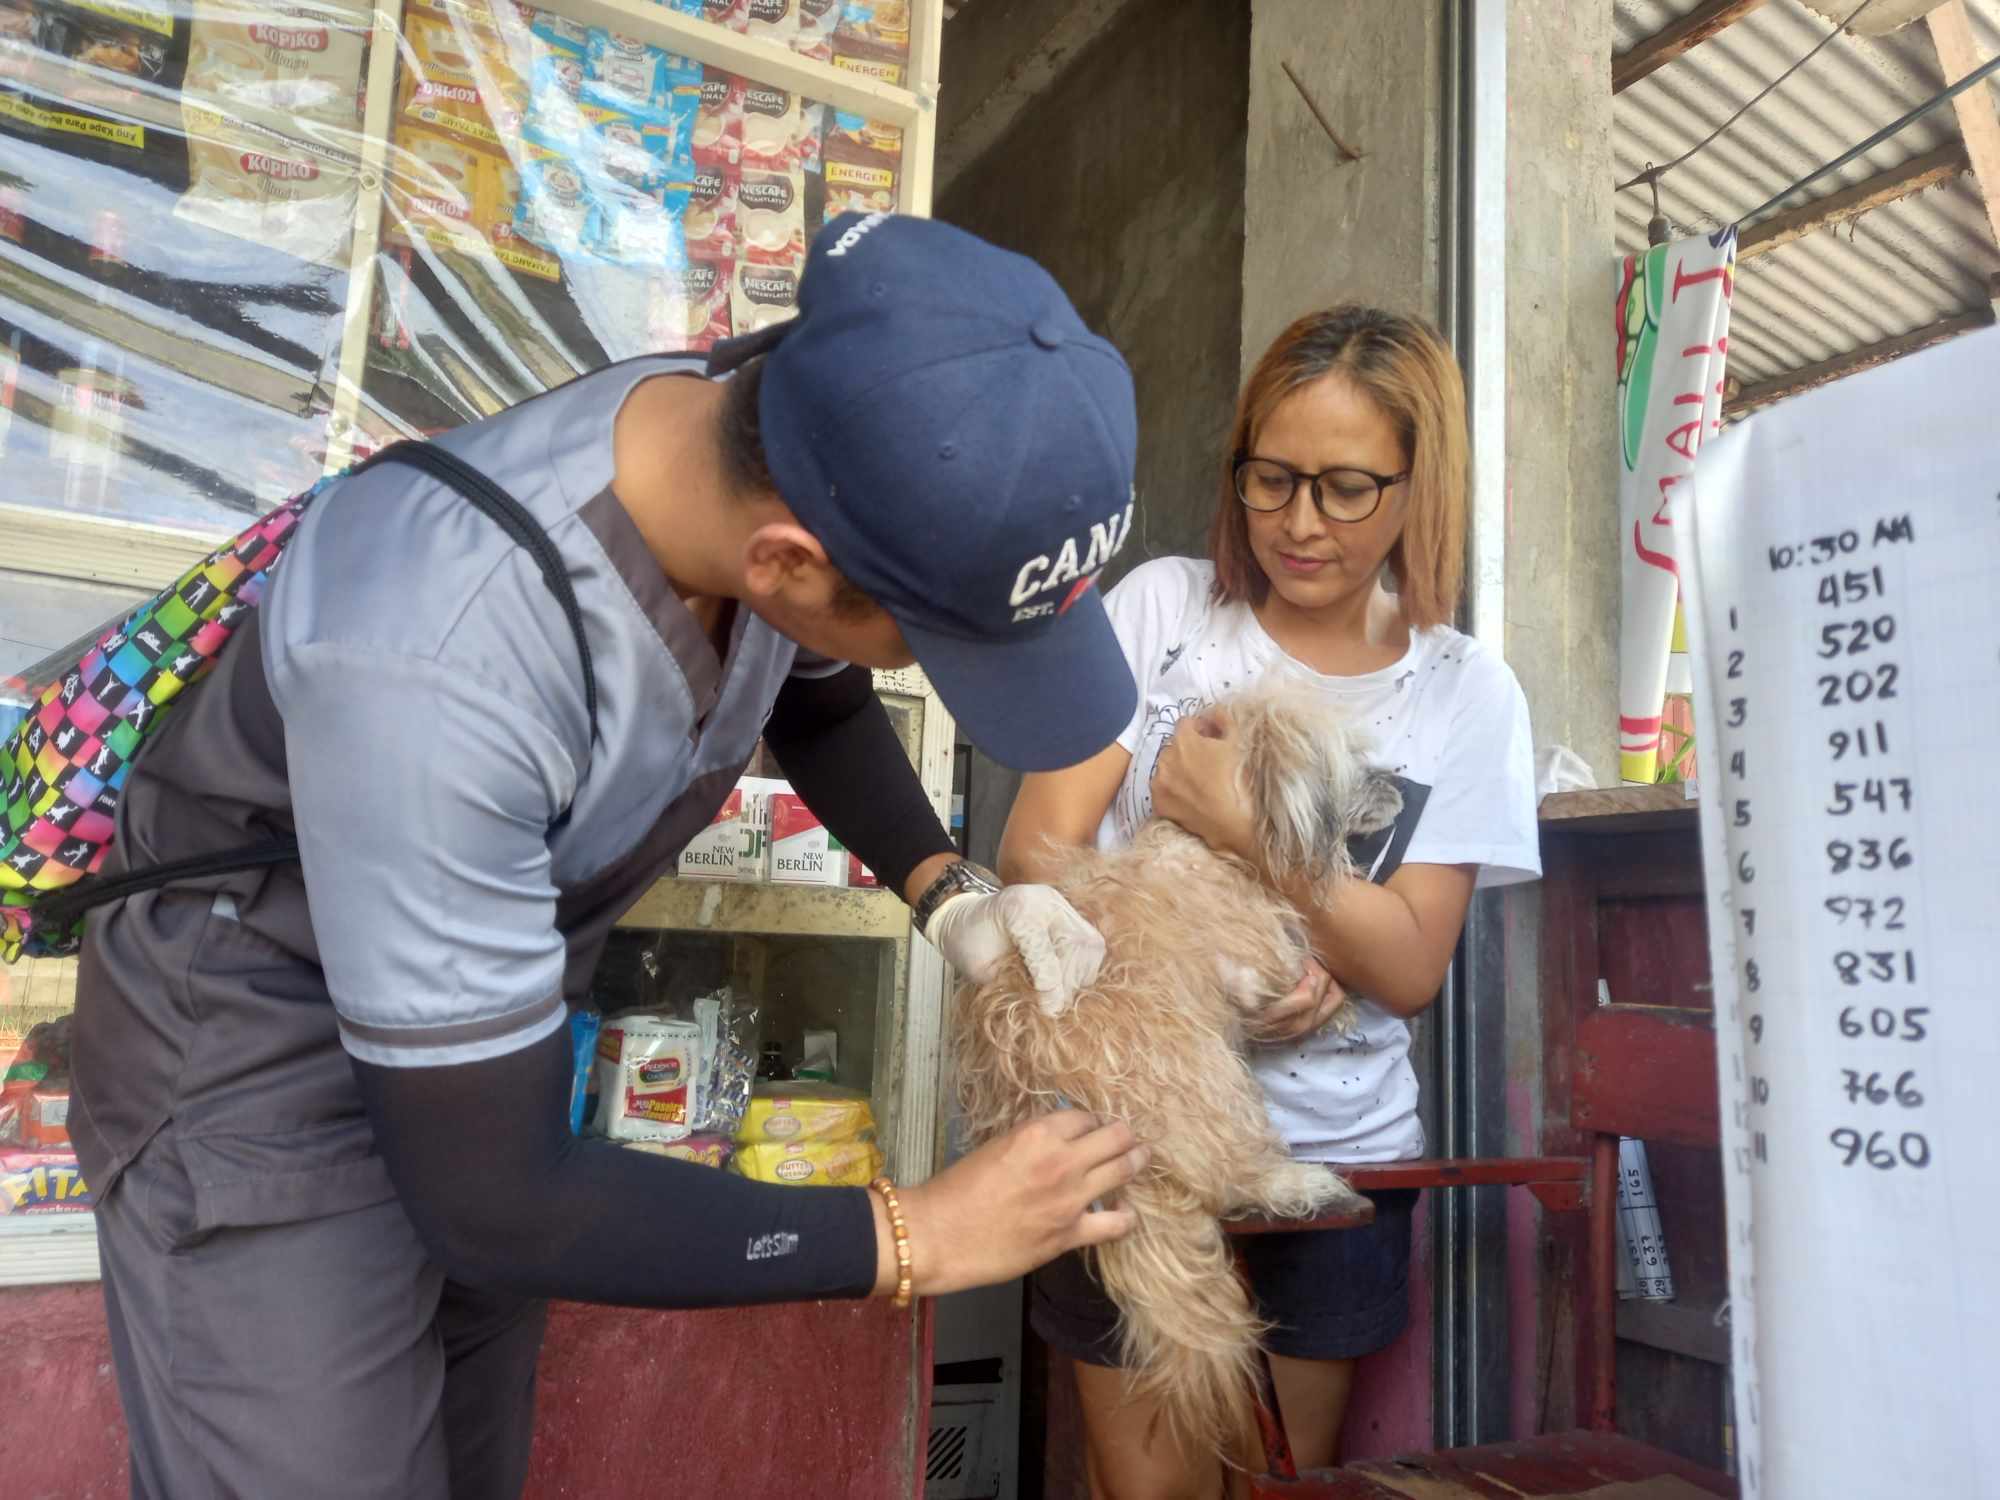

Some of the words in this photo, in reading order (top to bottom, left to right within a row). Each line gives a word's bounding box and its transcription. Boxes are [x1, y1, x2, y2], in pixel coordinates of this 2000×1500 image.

[256, 25, 320, 49] KOPIKO
[839, 61, 895, 78] ENERGEN
[423, 82, 476, 103] KOPIKO
[247, 153, 311, 178] KOPIKO
[831, 167, 889, 183] ENERGEN
[1769, 530, 1859, 572] 10:30
[1873, 513, 1914, 547] AM
[1817, 566, 1884, 608] 451
[1817, 615, 1896, 659] 520
[1727, 651, 1745, 679] 2
[1817, 663, 1899, 706] 202
[1726, 698, 1747, 728] 3
[1828, 721, 1889, 761] 911
[1730, 751, 1746, 779] 4
[1826, 778, 1913, 816] 547
[1733, 800, 1751, 827] 5
[684, 851, 734, 866] BERLIN
[712, 845, 735, 855] NEW
[776, 858, 823, 871] BERLIN
[803, 852, 824, 861] NEW
[1738, 851, 1755, 884] 6
[1740, 908, 1756, 937] 7
[1823, 897, 1905, 930] 972
[1745, 958, 1760, 992] 8
[1832, 949, 1916, 986] 831
[1749, 1013, 1764, 1044] 9
[1838, 1004, 1931, 1043] 605
[1841, 1067, 1925, 1109] 766
[1829, 1127, 1931, 1171] 960
[1655, 1279, 1667, 1296] 29
